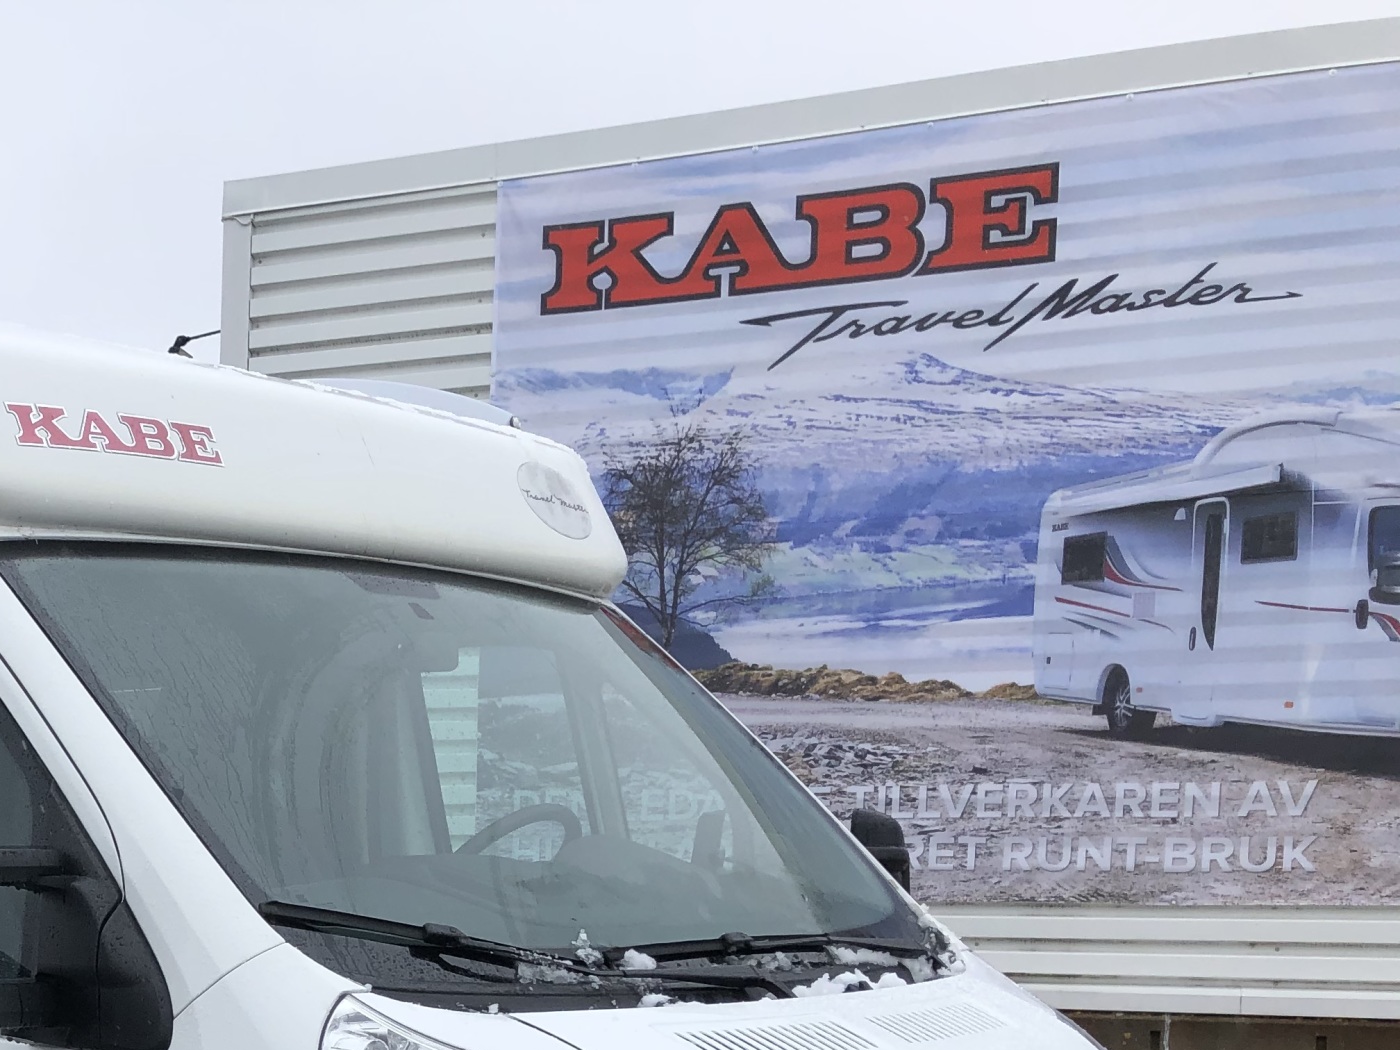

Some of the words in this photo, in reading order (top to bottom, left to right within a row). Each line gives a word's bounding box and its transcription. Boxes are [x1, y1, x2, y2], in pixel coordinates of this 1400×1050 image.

[540, 162, 1061, 317] KABE
[739, 283, 1040, 371] Travel
[983, 262, 1303, 353] Master
[2, 400, 226, 468] KABE
[847, 780, 1221, 820] TILLVERKAREN
[1236, 779, 1319, 818] AV
[902, 835, 988, 871] RET
[1002, 835, 1318, 873] RUNT-BRUK
